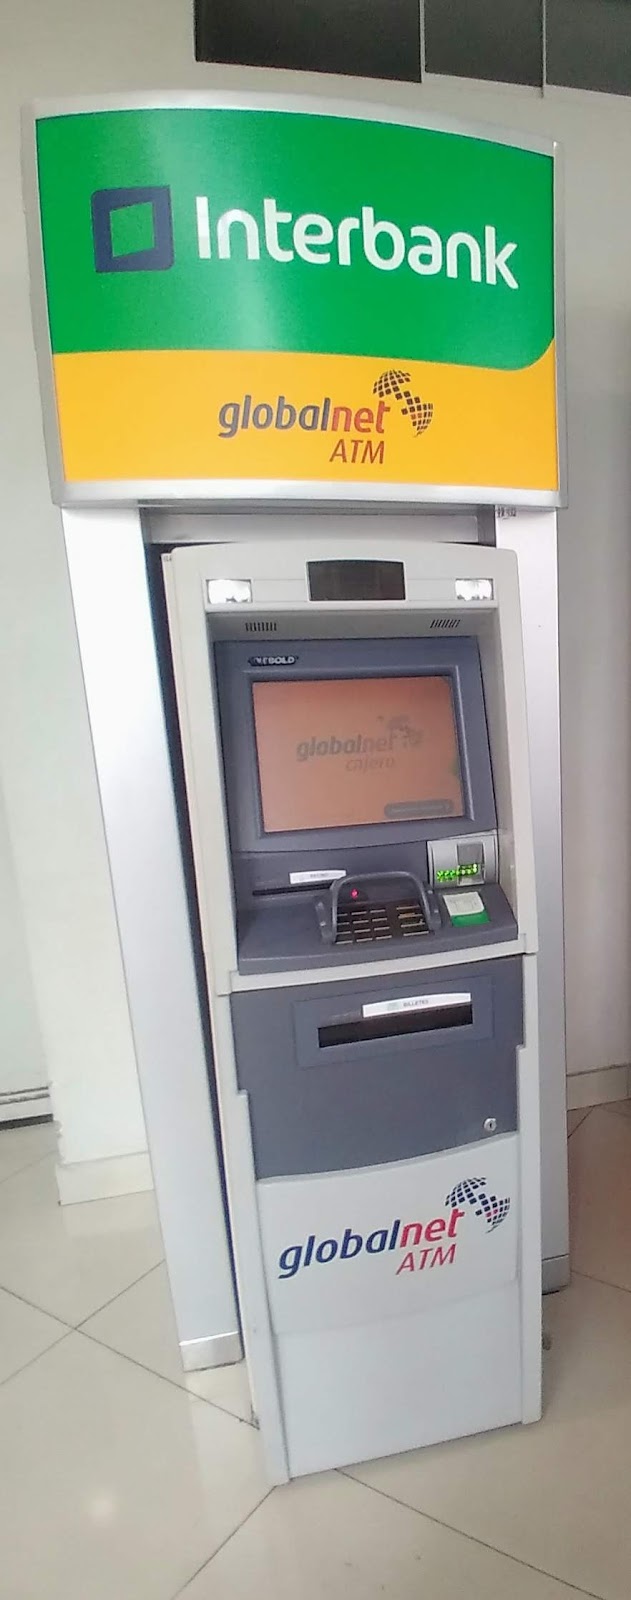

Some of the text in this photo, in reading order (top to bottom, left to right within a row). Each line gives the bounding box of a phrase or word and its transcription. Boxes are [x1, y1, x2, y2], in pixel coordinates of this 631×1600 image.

[195, 195, 519, 290] Interbank
[218, 394, 391, 438] globalnet
[329, 438, 385, 464] ATM
[278, 1208, 465, 1279] globalnet
[395, 1243, 456, 1276] ATM
